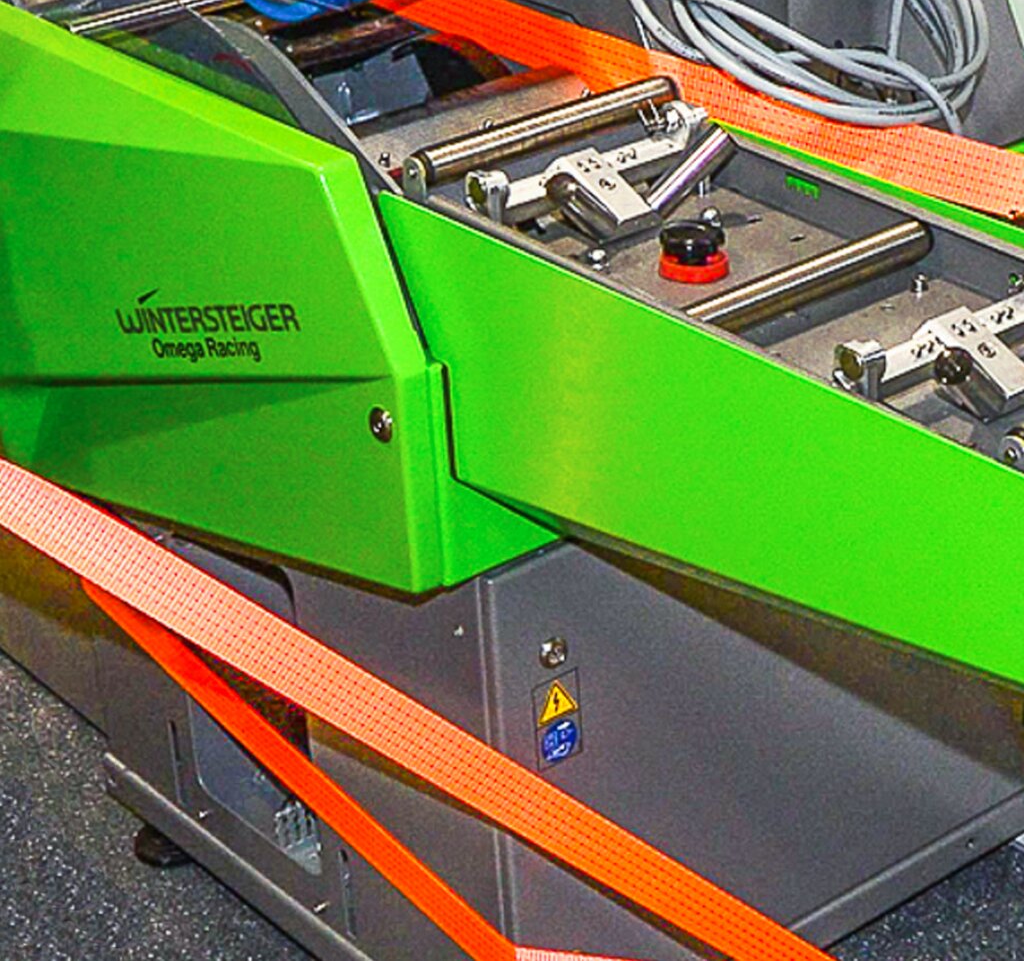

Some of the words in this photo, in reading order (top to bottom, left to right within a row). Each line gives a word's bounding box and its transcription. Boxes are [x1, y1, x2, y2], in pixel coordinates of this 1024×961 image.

[115, 303, 301, 334] WINTERSTEIGER
[151, 337, 204, 363] Omega
[204, 337, 261, 363] Racing
